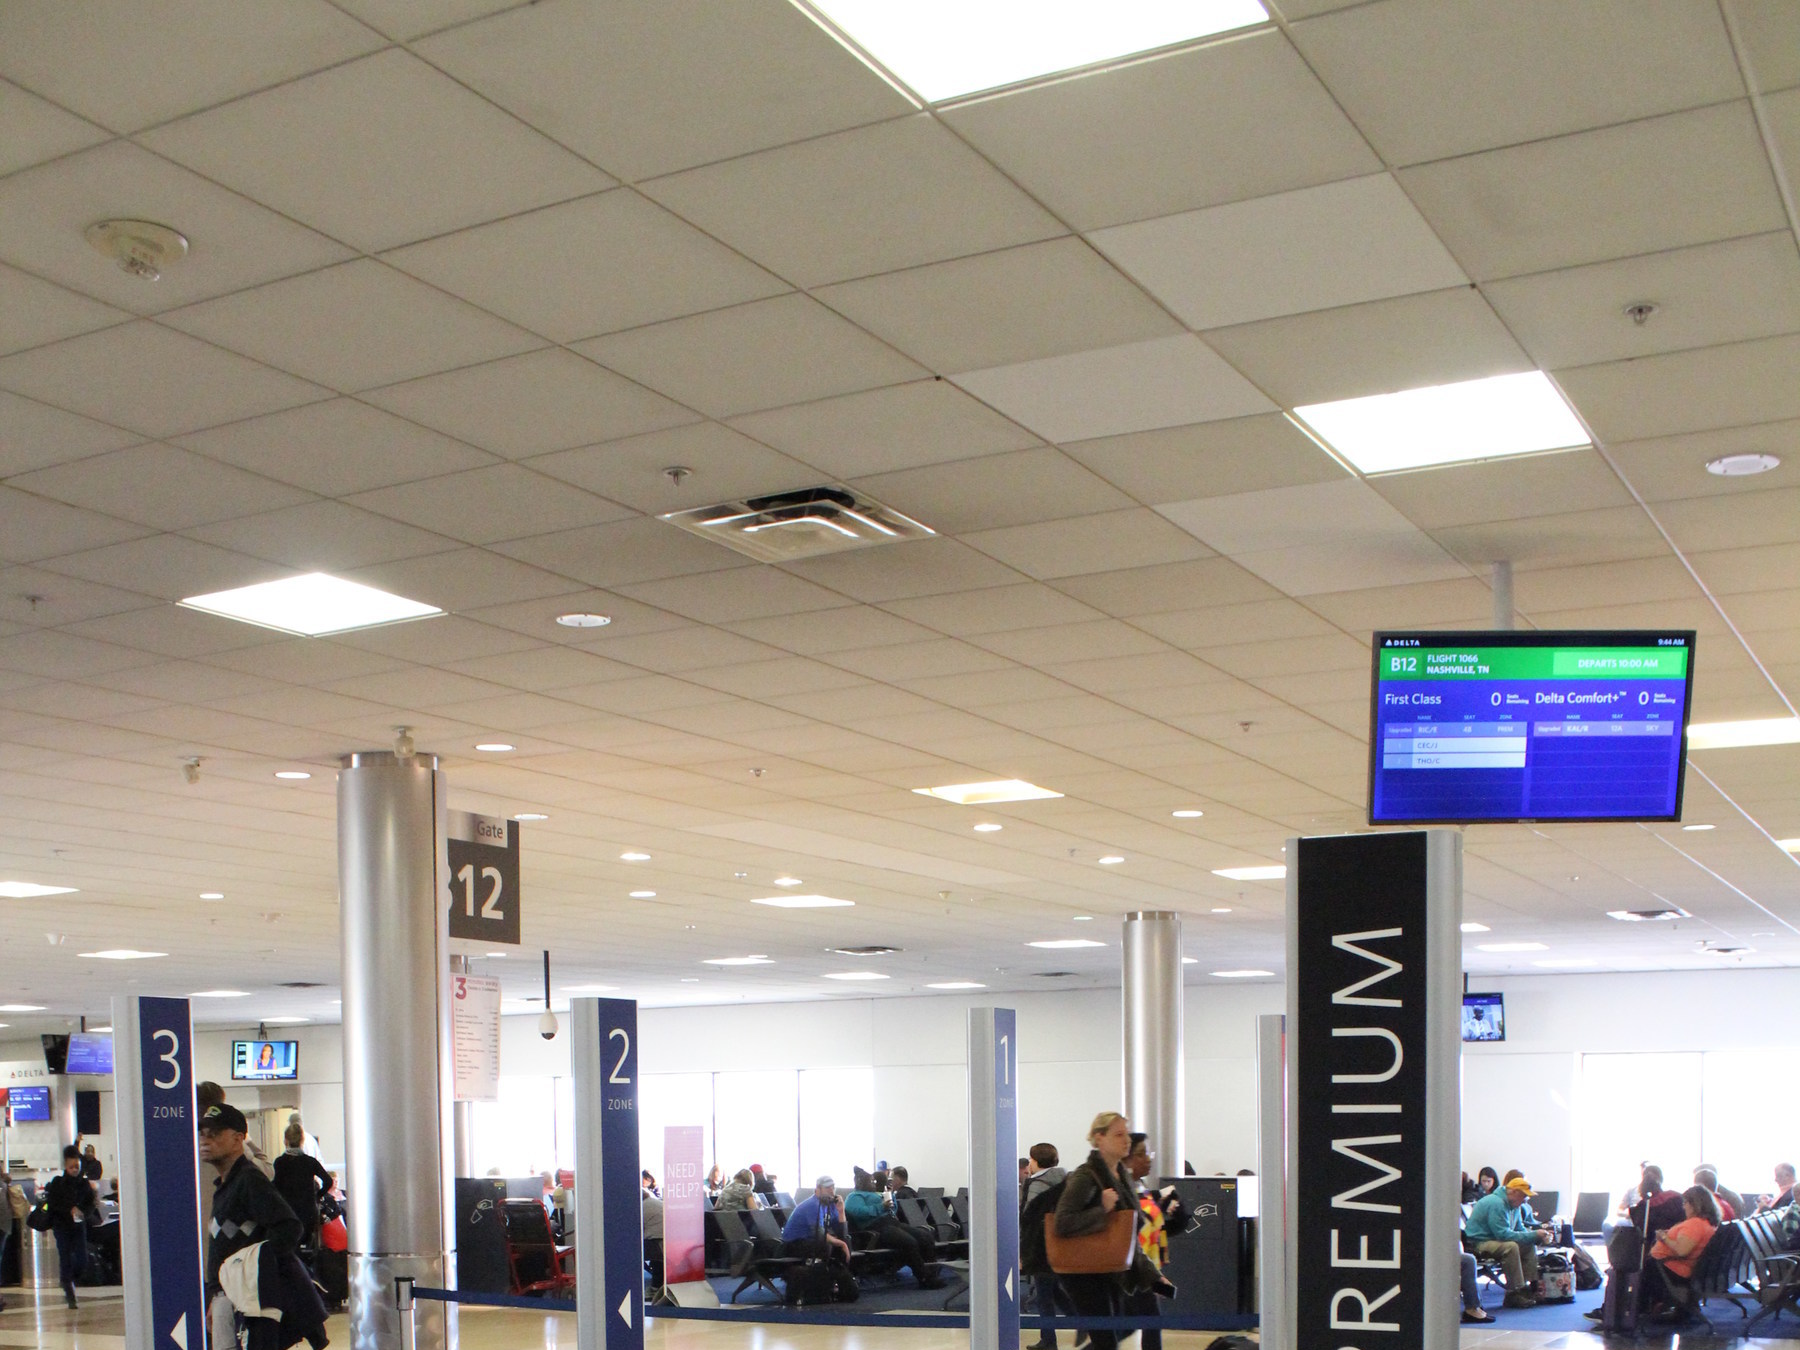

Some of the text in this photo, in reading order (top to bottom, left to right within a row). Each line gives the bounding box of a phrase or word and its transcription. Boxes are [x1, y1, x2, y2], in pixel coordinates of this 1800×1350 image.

[1673, 638, 1685, 646] AM
[1390, 657, 1417, 672] B12
[1427, 654, 1479, 663] FLIGHT 1066
[1577, 659, 1617, 668] DEPARTS
[1642, 658, 1659, 668] AM
[1426, 665, 1490, 675] NASHVILLE, TN
[1384, 692, 1442, 705] First Class
[1490, 692, 1502, 707] 0
[1535, 692, 1565, 705] Delta
[1638, 691, 1650, 706] 0
[1646, 724, 1660, 732] SKY
[476, 821, 504, 839] Gate
[455, 977, 467, 1000] 3
[152, 1029, 181, 1090] 3
[608, 1028, 631, 1084] 2
[1000, 1035, 1009, 1085] 1
[17, 1069, 44, 1078] DELTA
[608, 1098, 632, 1110] ZONE
[153, 1106, 185, 1118] ZONE
[667, 1162, 697, 1179] NEED
[667, 1182, 700, 1199] HELP?
